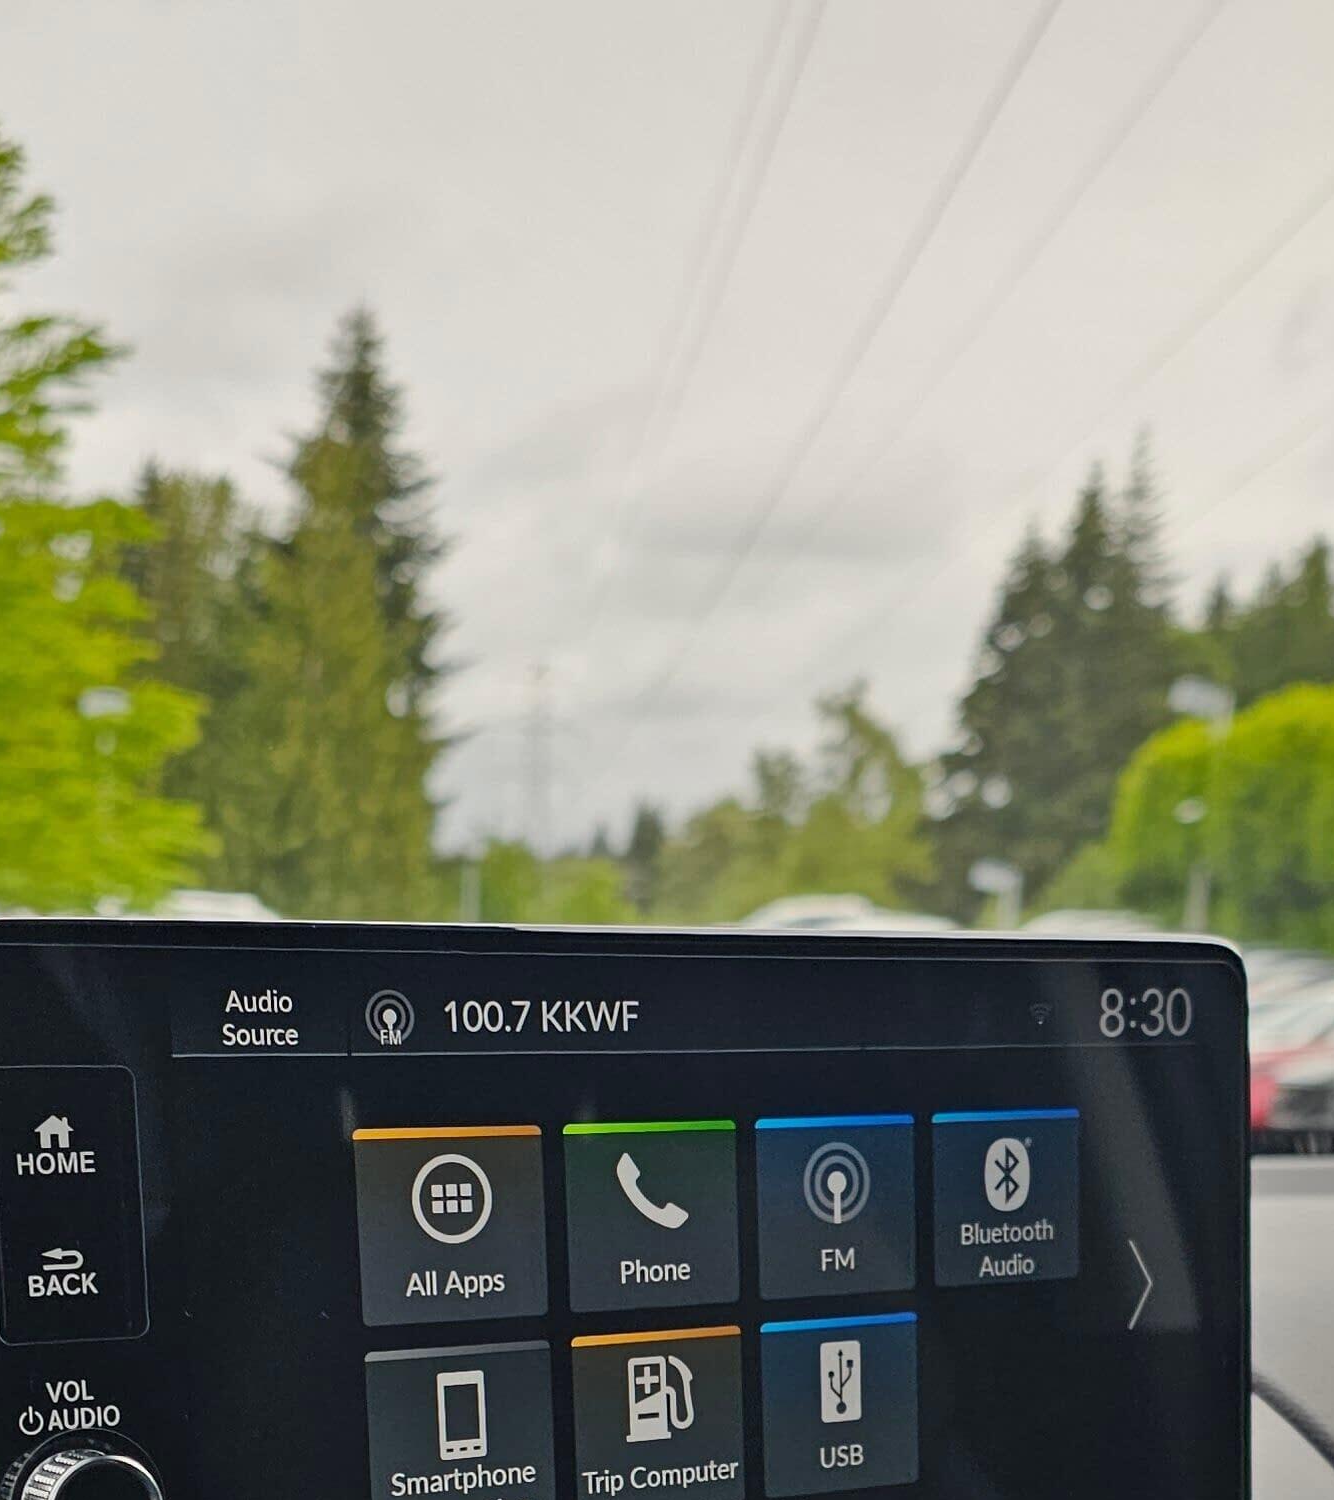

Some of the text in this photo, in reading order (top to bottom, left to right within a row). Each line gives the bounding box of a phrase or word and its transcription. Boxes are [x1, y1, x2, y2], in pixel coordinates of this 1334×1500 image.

[225, 989, 293, 1013] Audio
[1098, 987, 1192, 1038] 8:30
[444, 1000, 640, 1033] 100.7 KKWF
[222, 1023, 299, 1046] Source
[380, 1028, 402, 1046] FM
[16, 1150, 96, 1176] HOME
[960, 1218, 1054, 1246] Bluetooth
[620, 1259, 691, 1285] Phone
[821, 1247, 855, 1272] FM
[978, 1252, 1035, 1278] Audio
[27, 1271, 99, 1298] BACK
[405, 1270, 505, 1299] All Apps
[45, 1379, 95, 1404] VOL
[47, 1404, 121, 1432] AUDIO
[820, 1443, 864, 1469] USB
[390, 1459, 537, 1498] Smartphone
[581, 1460, 739, 1497] Trip Computer
